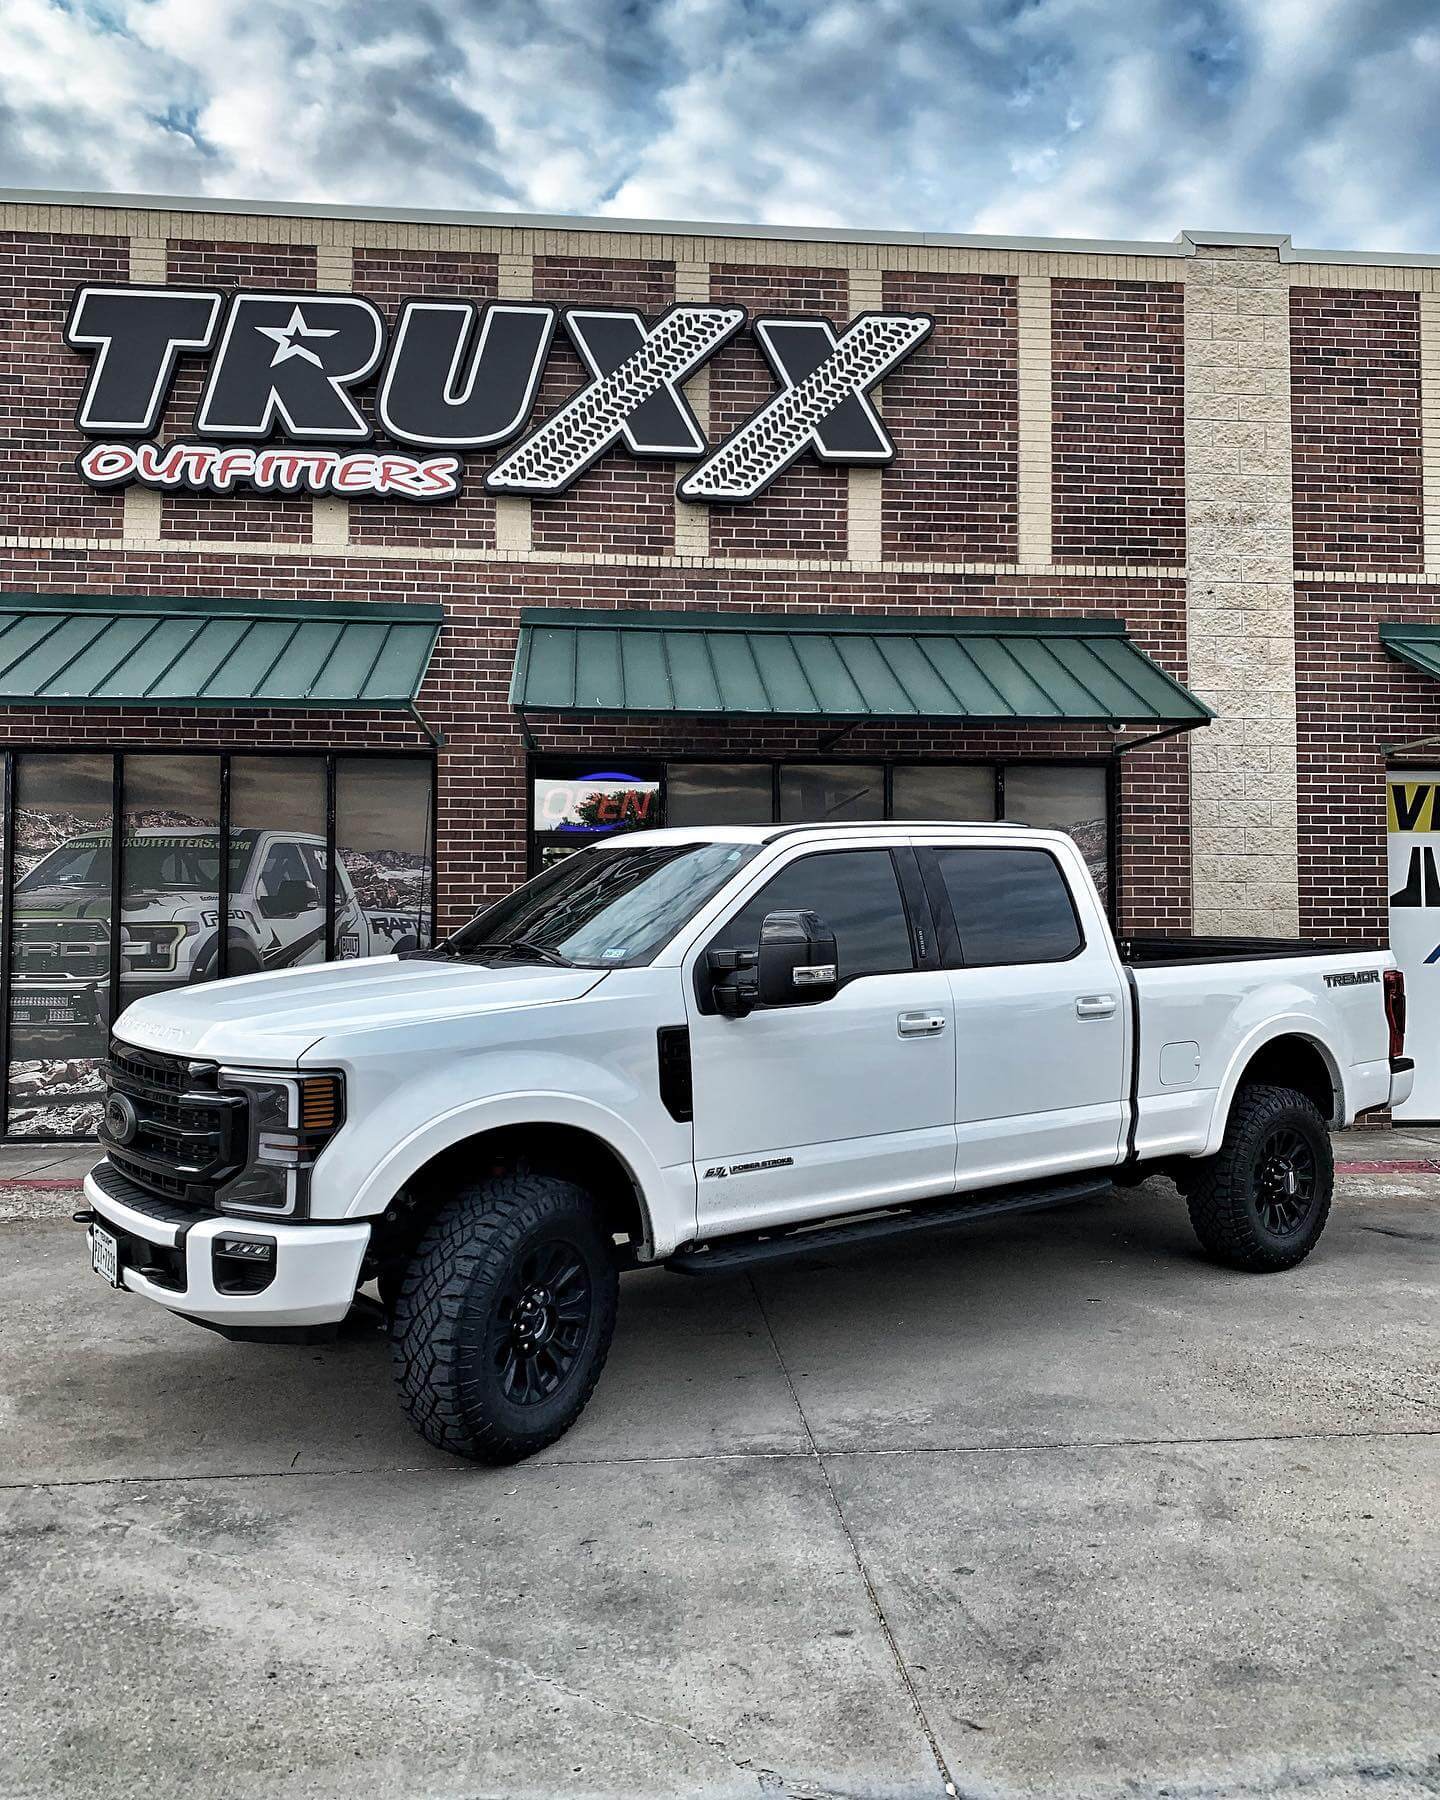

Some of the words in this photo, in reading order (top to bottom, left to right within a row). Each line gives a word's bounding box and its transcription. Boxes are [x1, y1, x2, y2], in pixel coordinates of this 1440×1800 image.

[66, 283, 934, 505] TRUXX
[80, 444, 461, 497] OUTFITTERS
[543, 787, 652, 819] OPEN
[1323, 969, 1381, 989] TREMOR
[731, 1161, 760, 1174] POWER
[761, 1156, 794, 1169] STROKE
